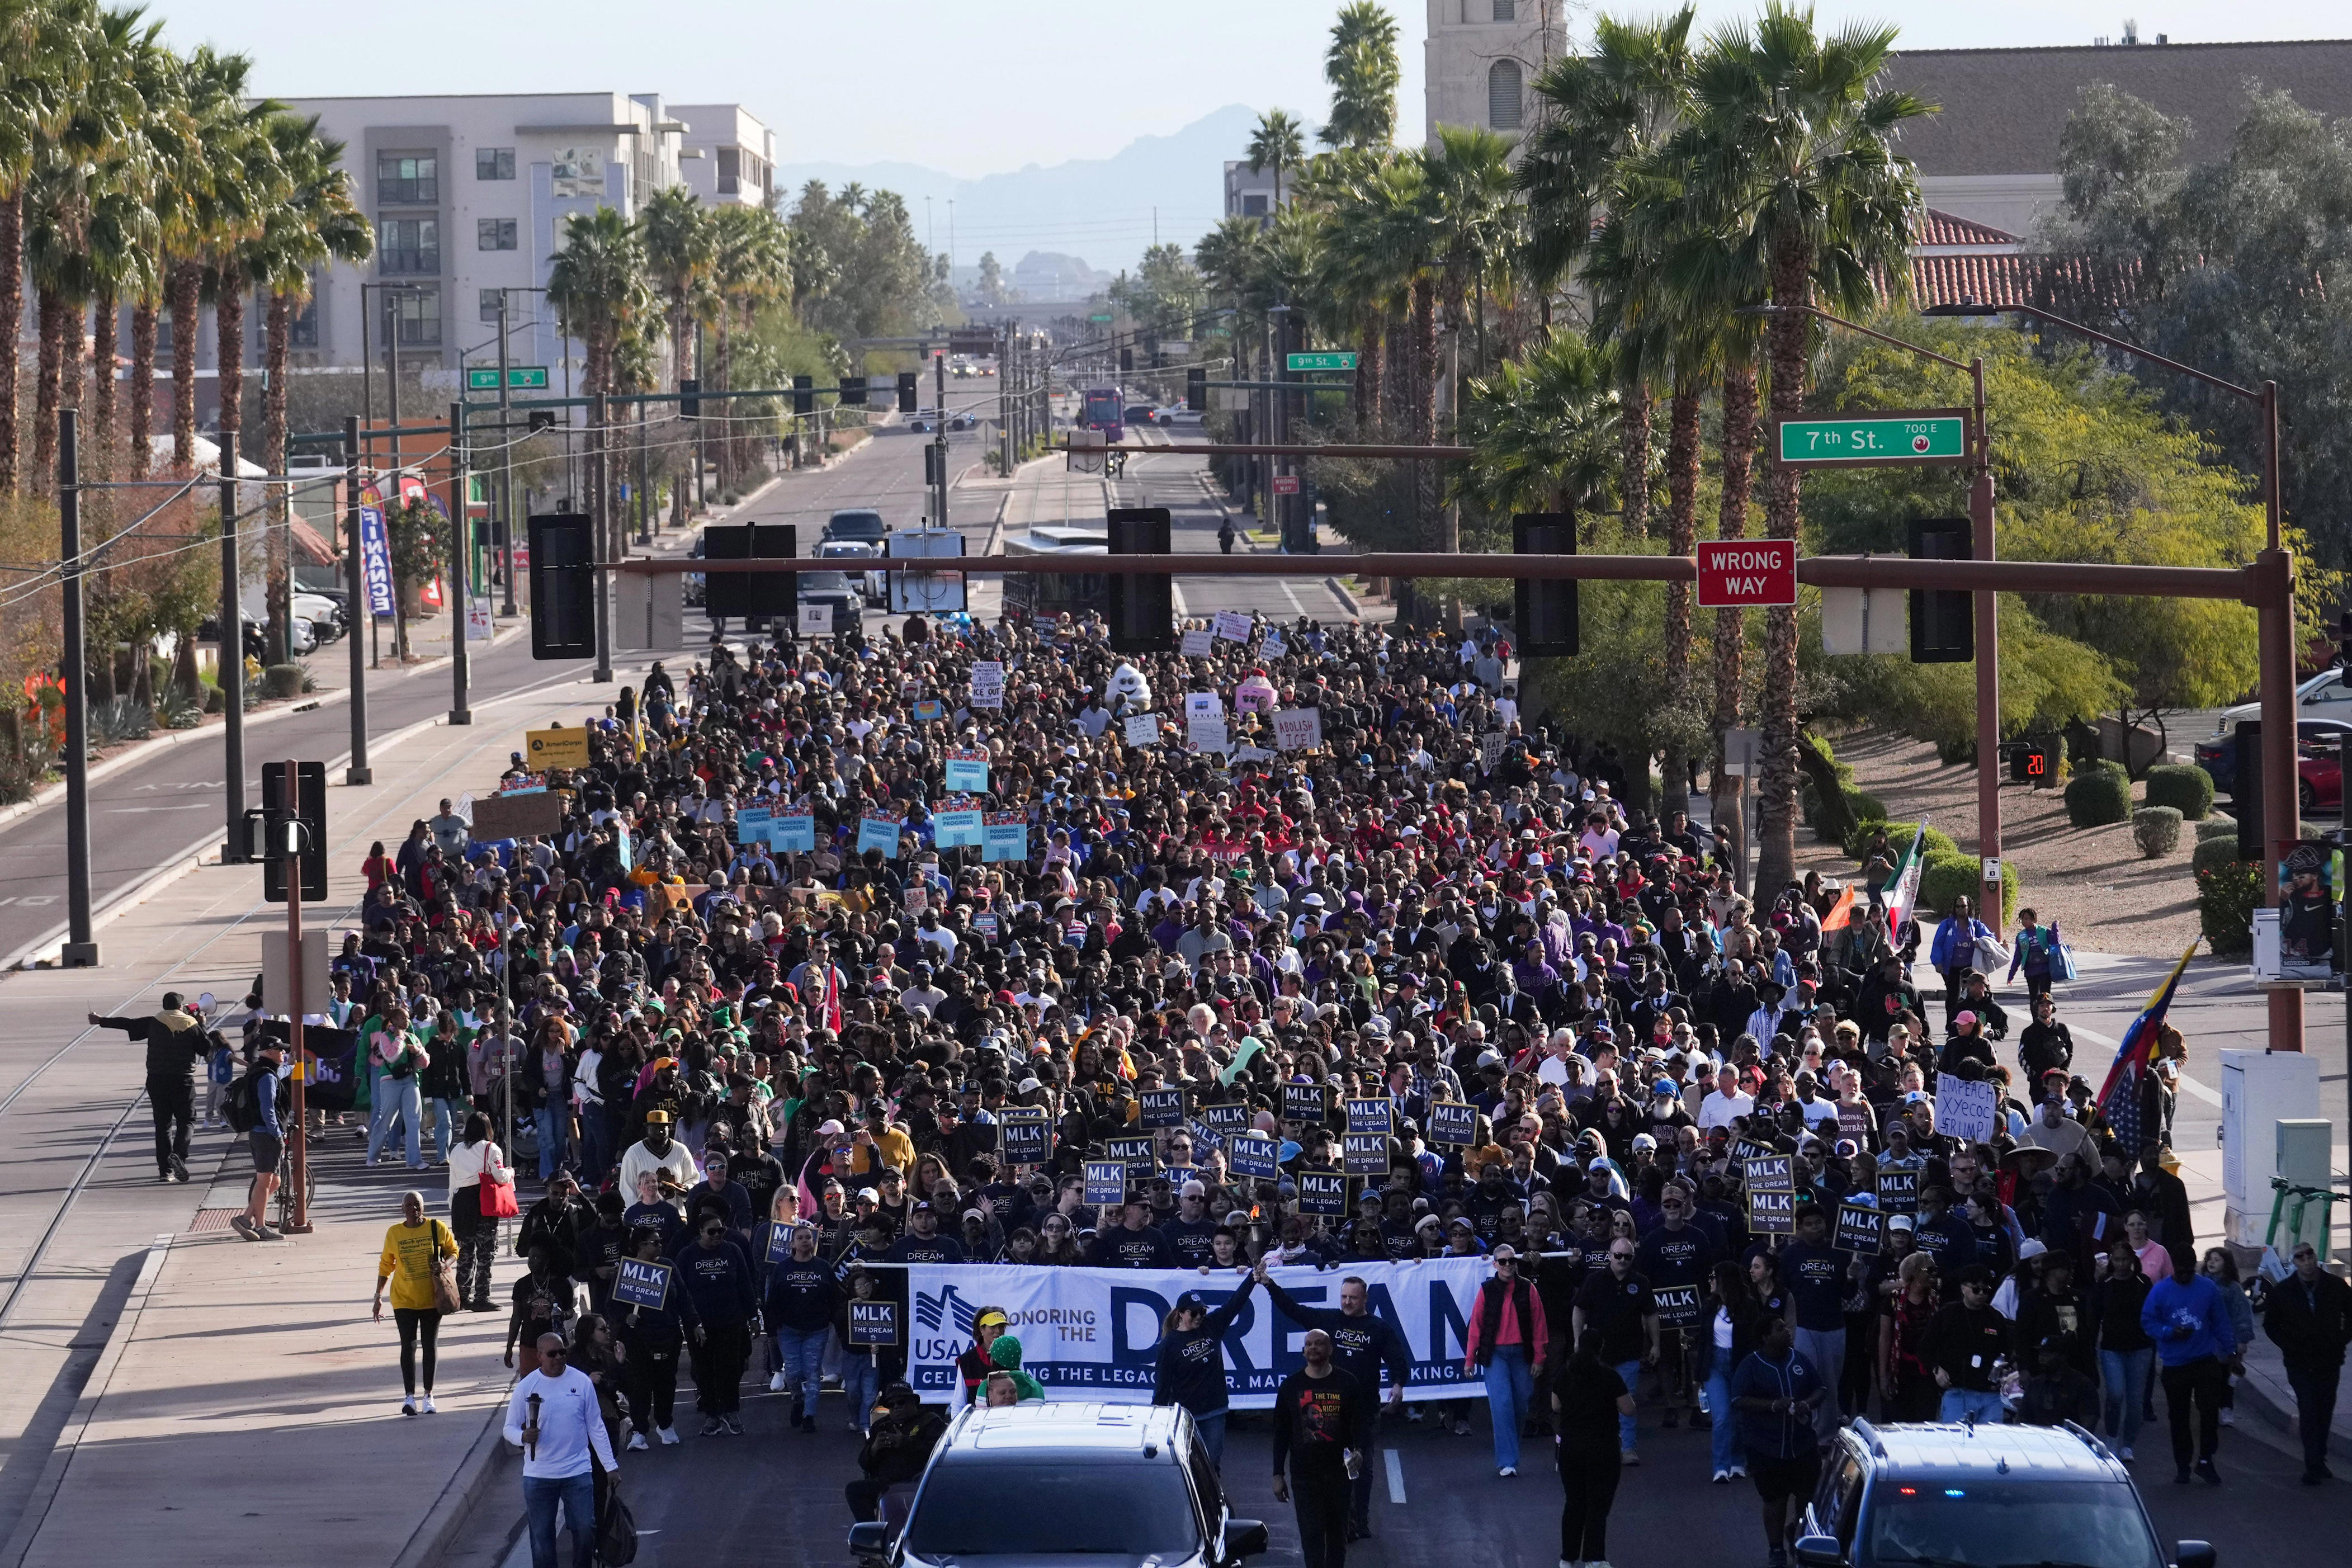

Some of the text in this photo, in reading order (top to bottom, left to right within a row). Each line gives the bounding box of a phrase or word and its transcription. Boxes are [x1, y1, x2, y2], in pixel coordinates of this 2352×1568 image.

[1298, 357, 1330, 366] 9th St.
[480, 374, 495, 384] 9th
[1905, 423, 1937, 434] 700 E
[1806, 430, 1883, 450] 7th St.
[1711, 551, 1782, 570] WRONG
[1725, 577, 1768, 595] WAY
[1279, 720, 1314, 734] ABOLISH
[1287, 733, 1315, 747] ICE!!
[2028, 754, 2043, 775] 20
[867, 823, 892, 831] POWERING
[1286, 1088, 1321, 1102] MLK
[1941, 1074, 1994, 1103] IMPEACH
[1142, 1093, 1179, 1108] MLK
[1286, 1099, 1321, 1107] HONORING
[1208, 1108, 1245, 1123] MLK
[1350, 1102, 1387, 1116] MLK
[1435, 1107, 1472, 1123] MLK
[1434, 1121, 1472, 1129] CELEBRATE
[1006, 1126, 1041, 1142] MLK
[1191, 1122, 1223, 1147] MLK
[1110, 1141, 1150, 1158] MLK
[1234, 1138, 1273, 1158] MLK
[1346, 1136, 1383, 1151] MLK
[1234, 1151, 1273, 1163] HONORING
[1249, 1160, 1273, 1169] DREAM
[1732, 1160, 1742, 1169] THE
[1748, 1160, 1788, 1177] MLK
[1088, 1166, 1121, 1180] MLK
[1749, 1174, 1788, 1183] HONORING
[1302, 1177, 1342, 1193] MLK
[1881, 1175, 1915, 1191] MLK
[1753, 1194, 1791, 1210] MLK
[634, 1217, 665, 1225] DREAM
[1841, 1210, 1879, 1231] MLK
[1178, 1238, 1212, 1246] DREAM
[1854, 1234, 1877, 1243] DREAM
[1916, 1232, 1949, 1245] DREAM
[1120, 1245, 1154, 1253] DREAM
[1661, 1244, 1695, 1254] DREAM
[907, 1252, 944, 1261] DREAM
[1585, 1254, 1610, 1262] DREA
[695, 1259, 729, 1269] DREAM
[1800, 1262, 1835, 1272] DREAM
[622, 1262, 664, 1286] MLK
[620, 1283, 661, 1297] THE DREAM
[621, 1278, 662, 1292] HONORING
[1654, 1291, 1694, 1309] MLK
[853, 1306, 892, 1321] MLK
[1007, 1309, 1095, 1326] ONORING
[1058, 1326, 1096, 1342] THE
[1335, 1330, 1371, 1344] DREAM
[1182, 1337, 1213, 1357] DREAM
[1058, 1368, 1093, 1381] THE
[1102, 1368, 1156, 1384] LEGAC
[1410, 1364, 1460, 1382] KING,
